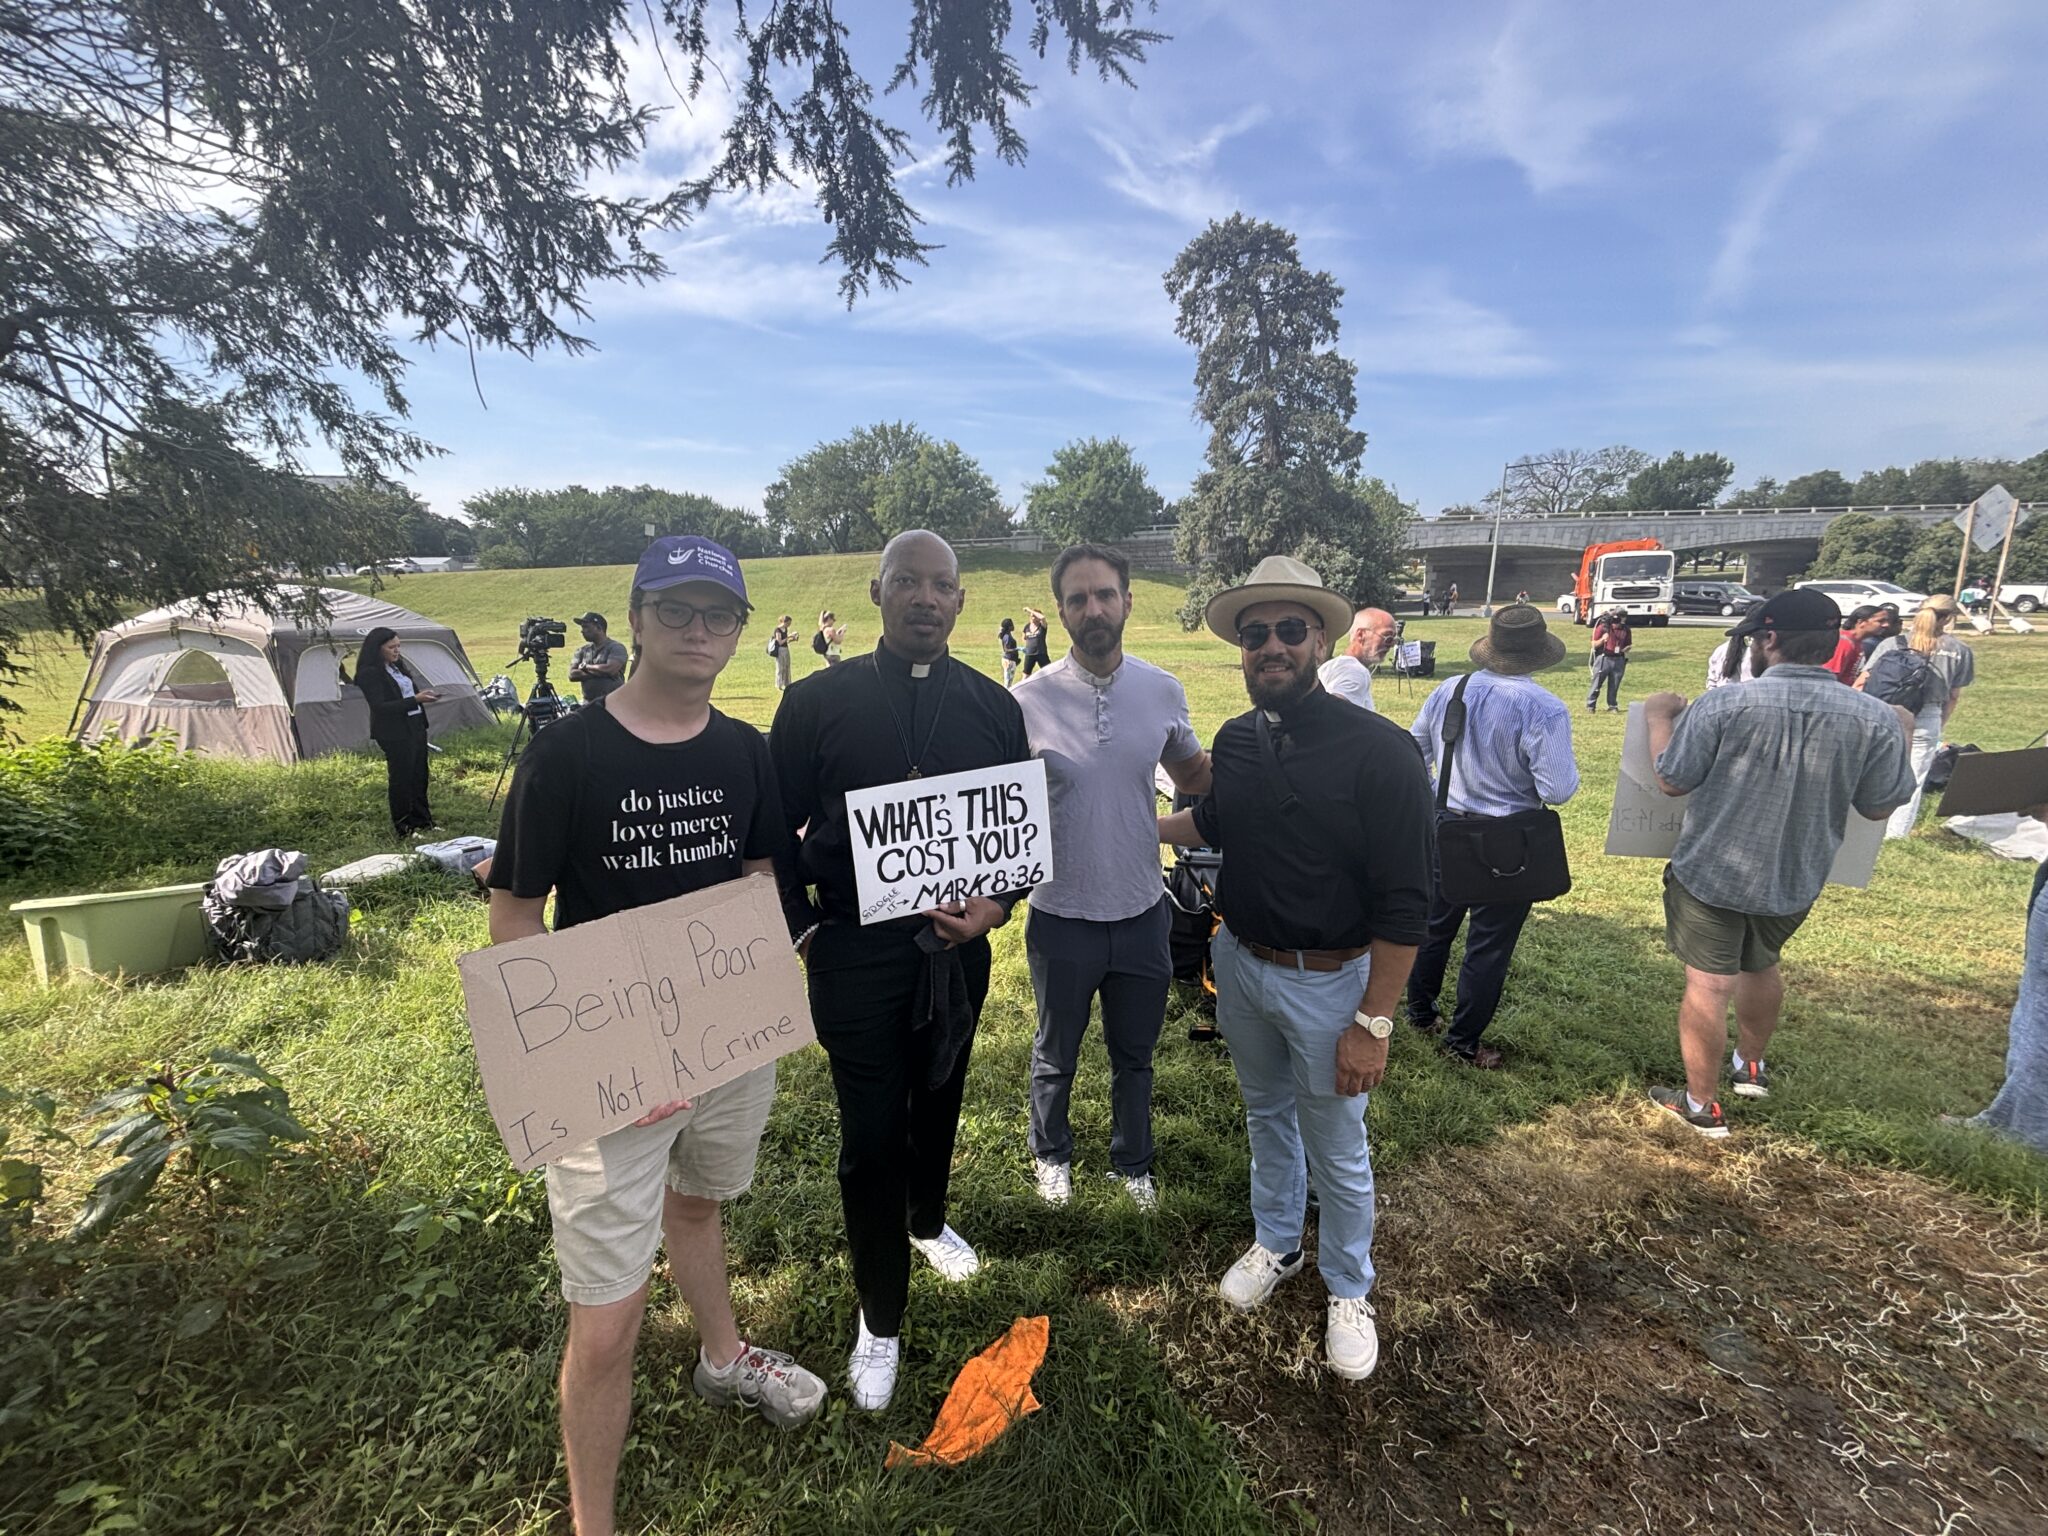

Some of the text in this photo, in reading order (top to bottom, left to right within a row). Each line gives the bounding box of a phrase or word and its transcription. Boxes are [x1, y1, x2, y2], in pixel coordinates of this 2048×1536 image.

[621, 785, 724, 815] do justice
[957, 782, 1028, 831] THIS
[611, 814, 733, 842] love mercy
[602, 833, 739, 870] walk humbly
[877, 823, 1038, 883] COST YOU?
[862, 887, 900, 920] GOOGLE
[887, 900, 897, 914] IT
[911, 862, 1044, 910] MARK 8:36
[498, 920, 768, 1054] Being Poor
[510, 1015, 796, 1163] Is Not A Crime
